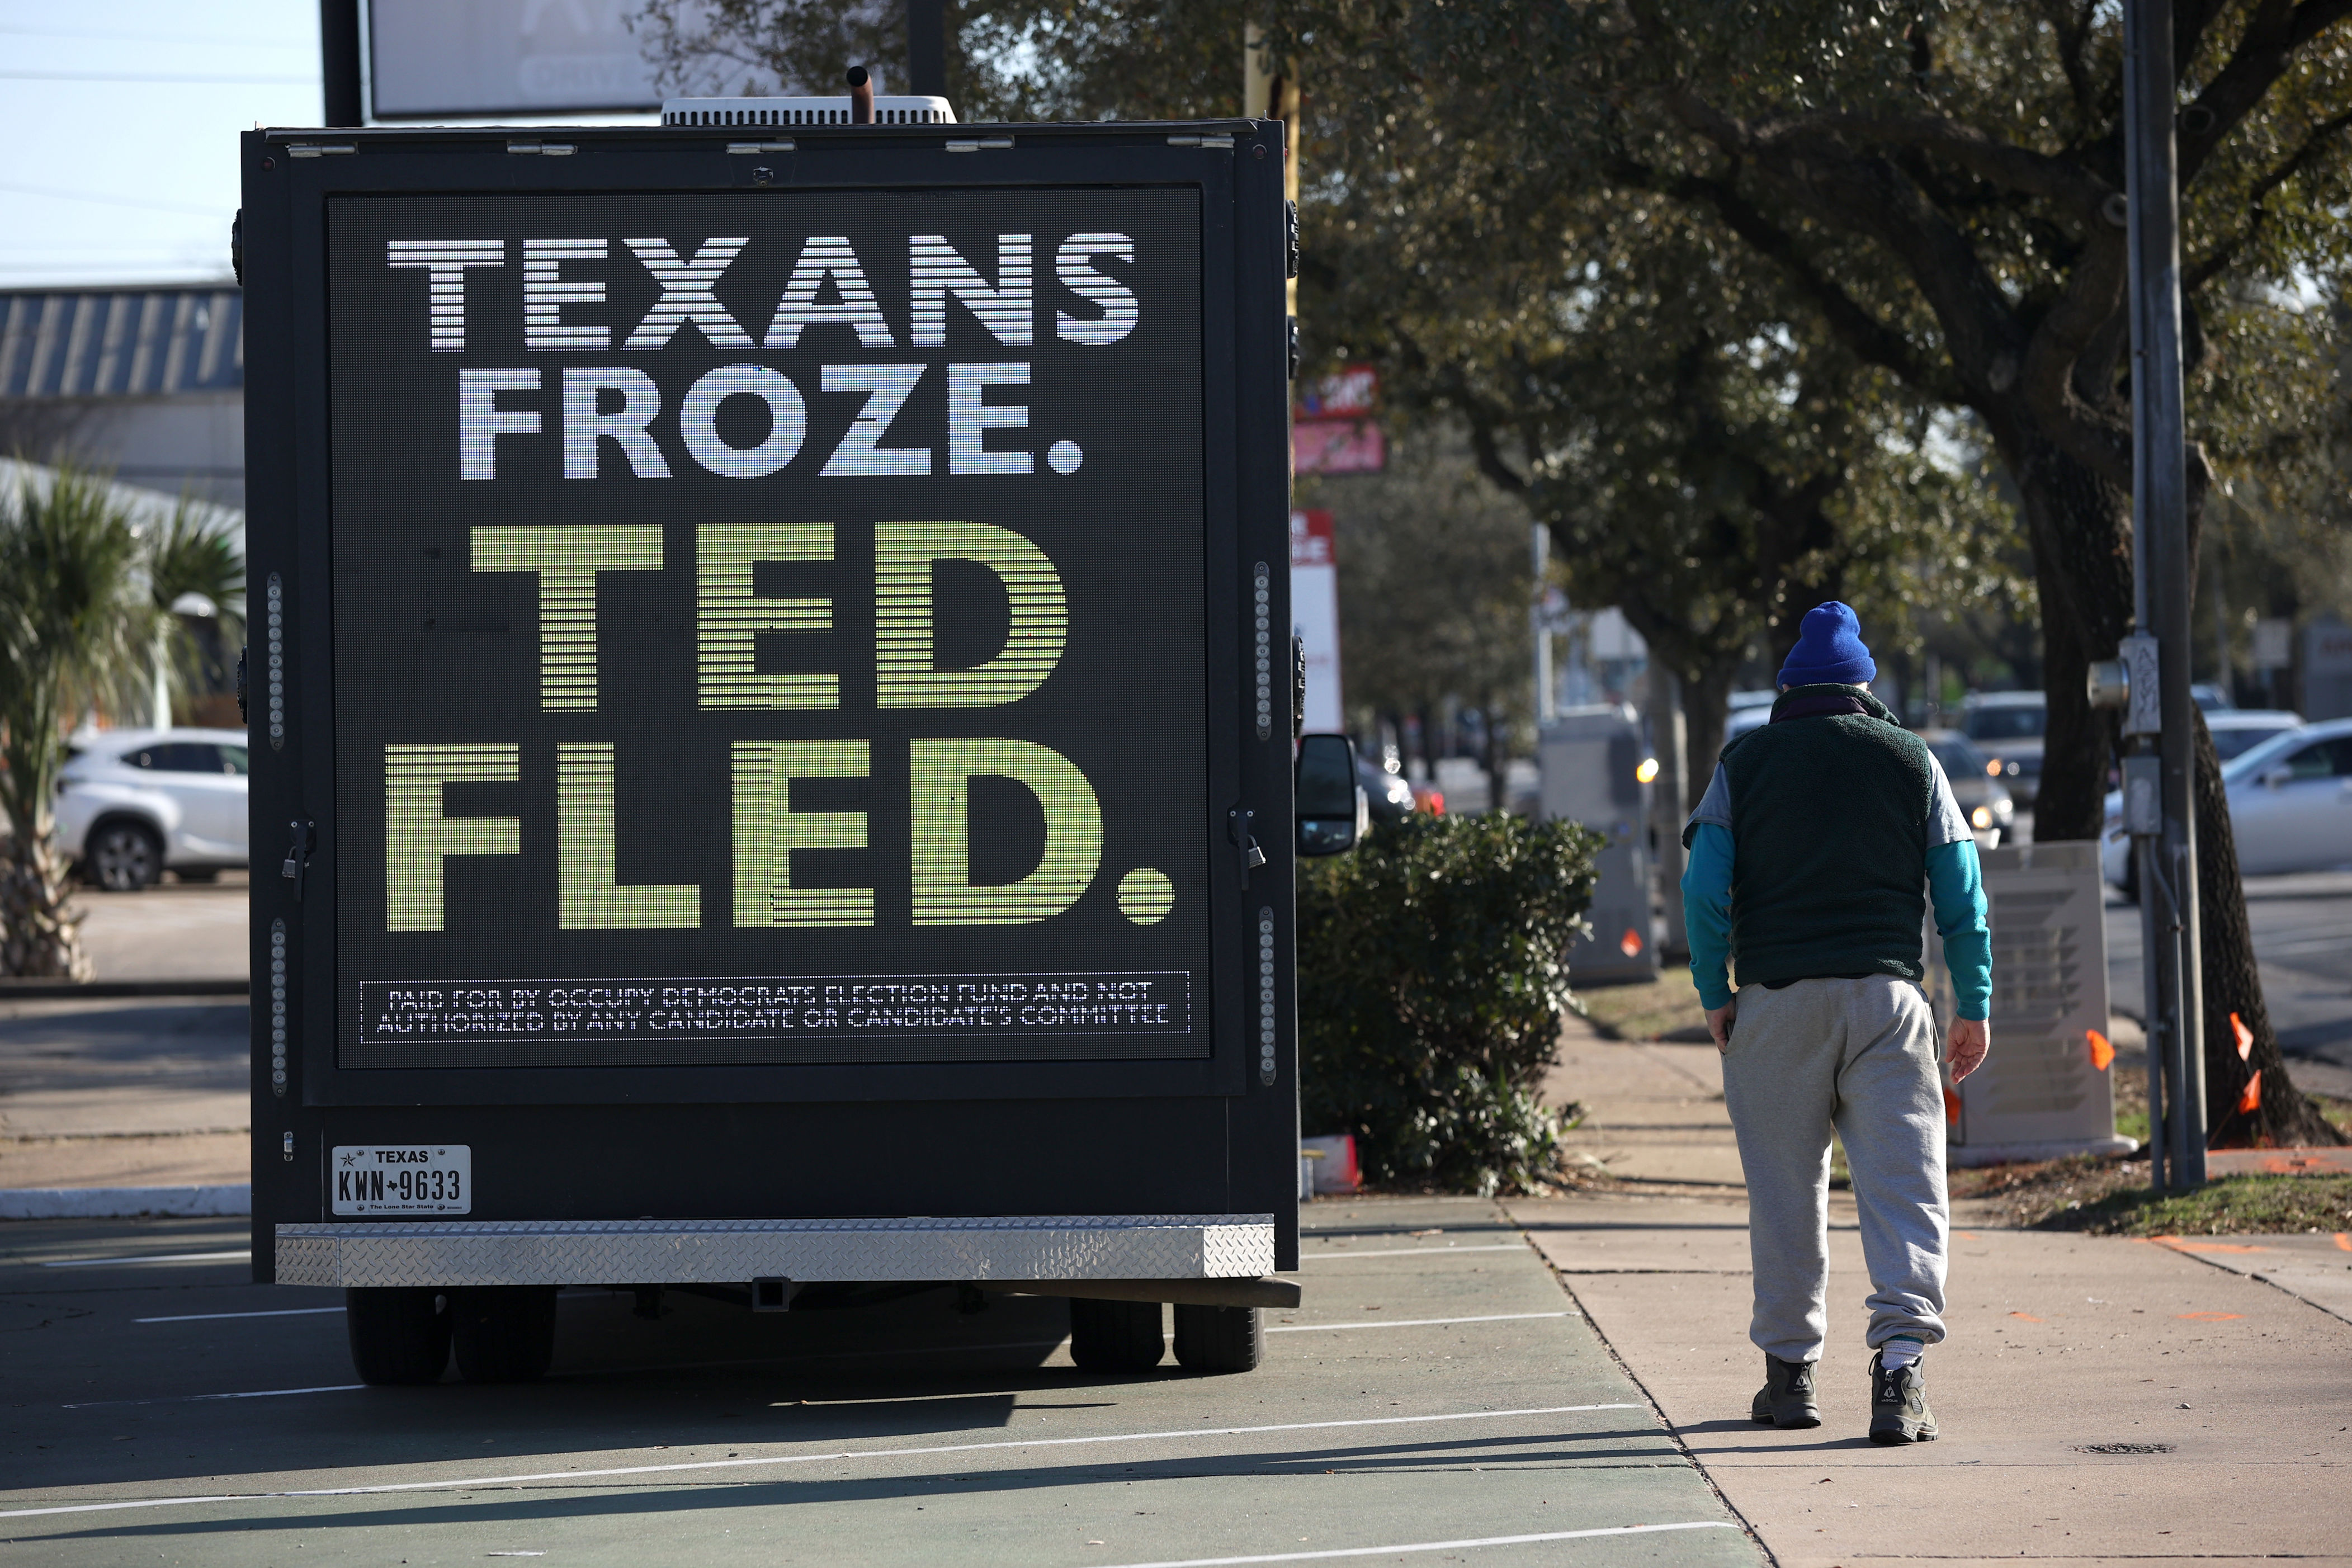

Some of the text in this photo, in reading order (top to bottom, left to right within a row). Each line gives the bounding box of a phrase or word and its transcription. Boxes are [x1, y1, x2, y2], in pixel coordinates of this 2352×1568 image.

[386, 233, 1139, 352] TEXANS
[459, 362, 1083, 480] FROZE.
[470, 521, 1068, 712] TED
[385, 738, 1175, 931] FLED.
[377, 1013, 544, 1032] AUTHORIZED
[553, 1011, 582, 1031] BY
[587, 1011, 641, 1030] ANY
[649, 1009, 794, 1029] CANDIDATE
[802, 1008, 838, 1027] OR
[1019, 1004, 1168, 1026] COMMITTEE
[390, 991, 444, 1010] PAID
[454, 990, 502, 1009] FOR
[511, 990, 540, 1009] BY
[549, 988, 654, 1008] OCCUPY
[826, 985, 948, 1005] ELECTION
[957, 984, 1027, 1003] FUND
[1033, 983, 1088, 1003] AND
[1097, 982, 1153, 1002] NOT
[339, 1170, 460, 1201] KWN 9633
[375, 1151, 428, 1163] TEXAS
